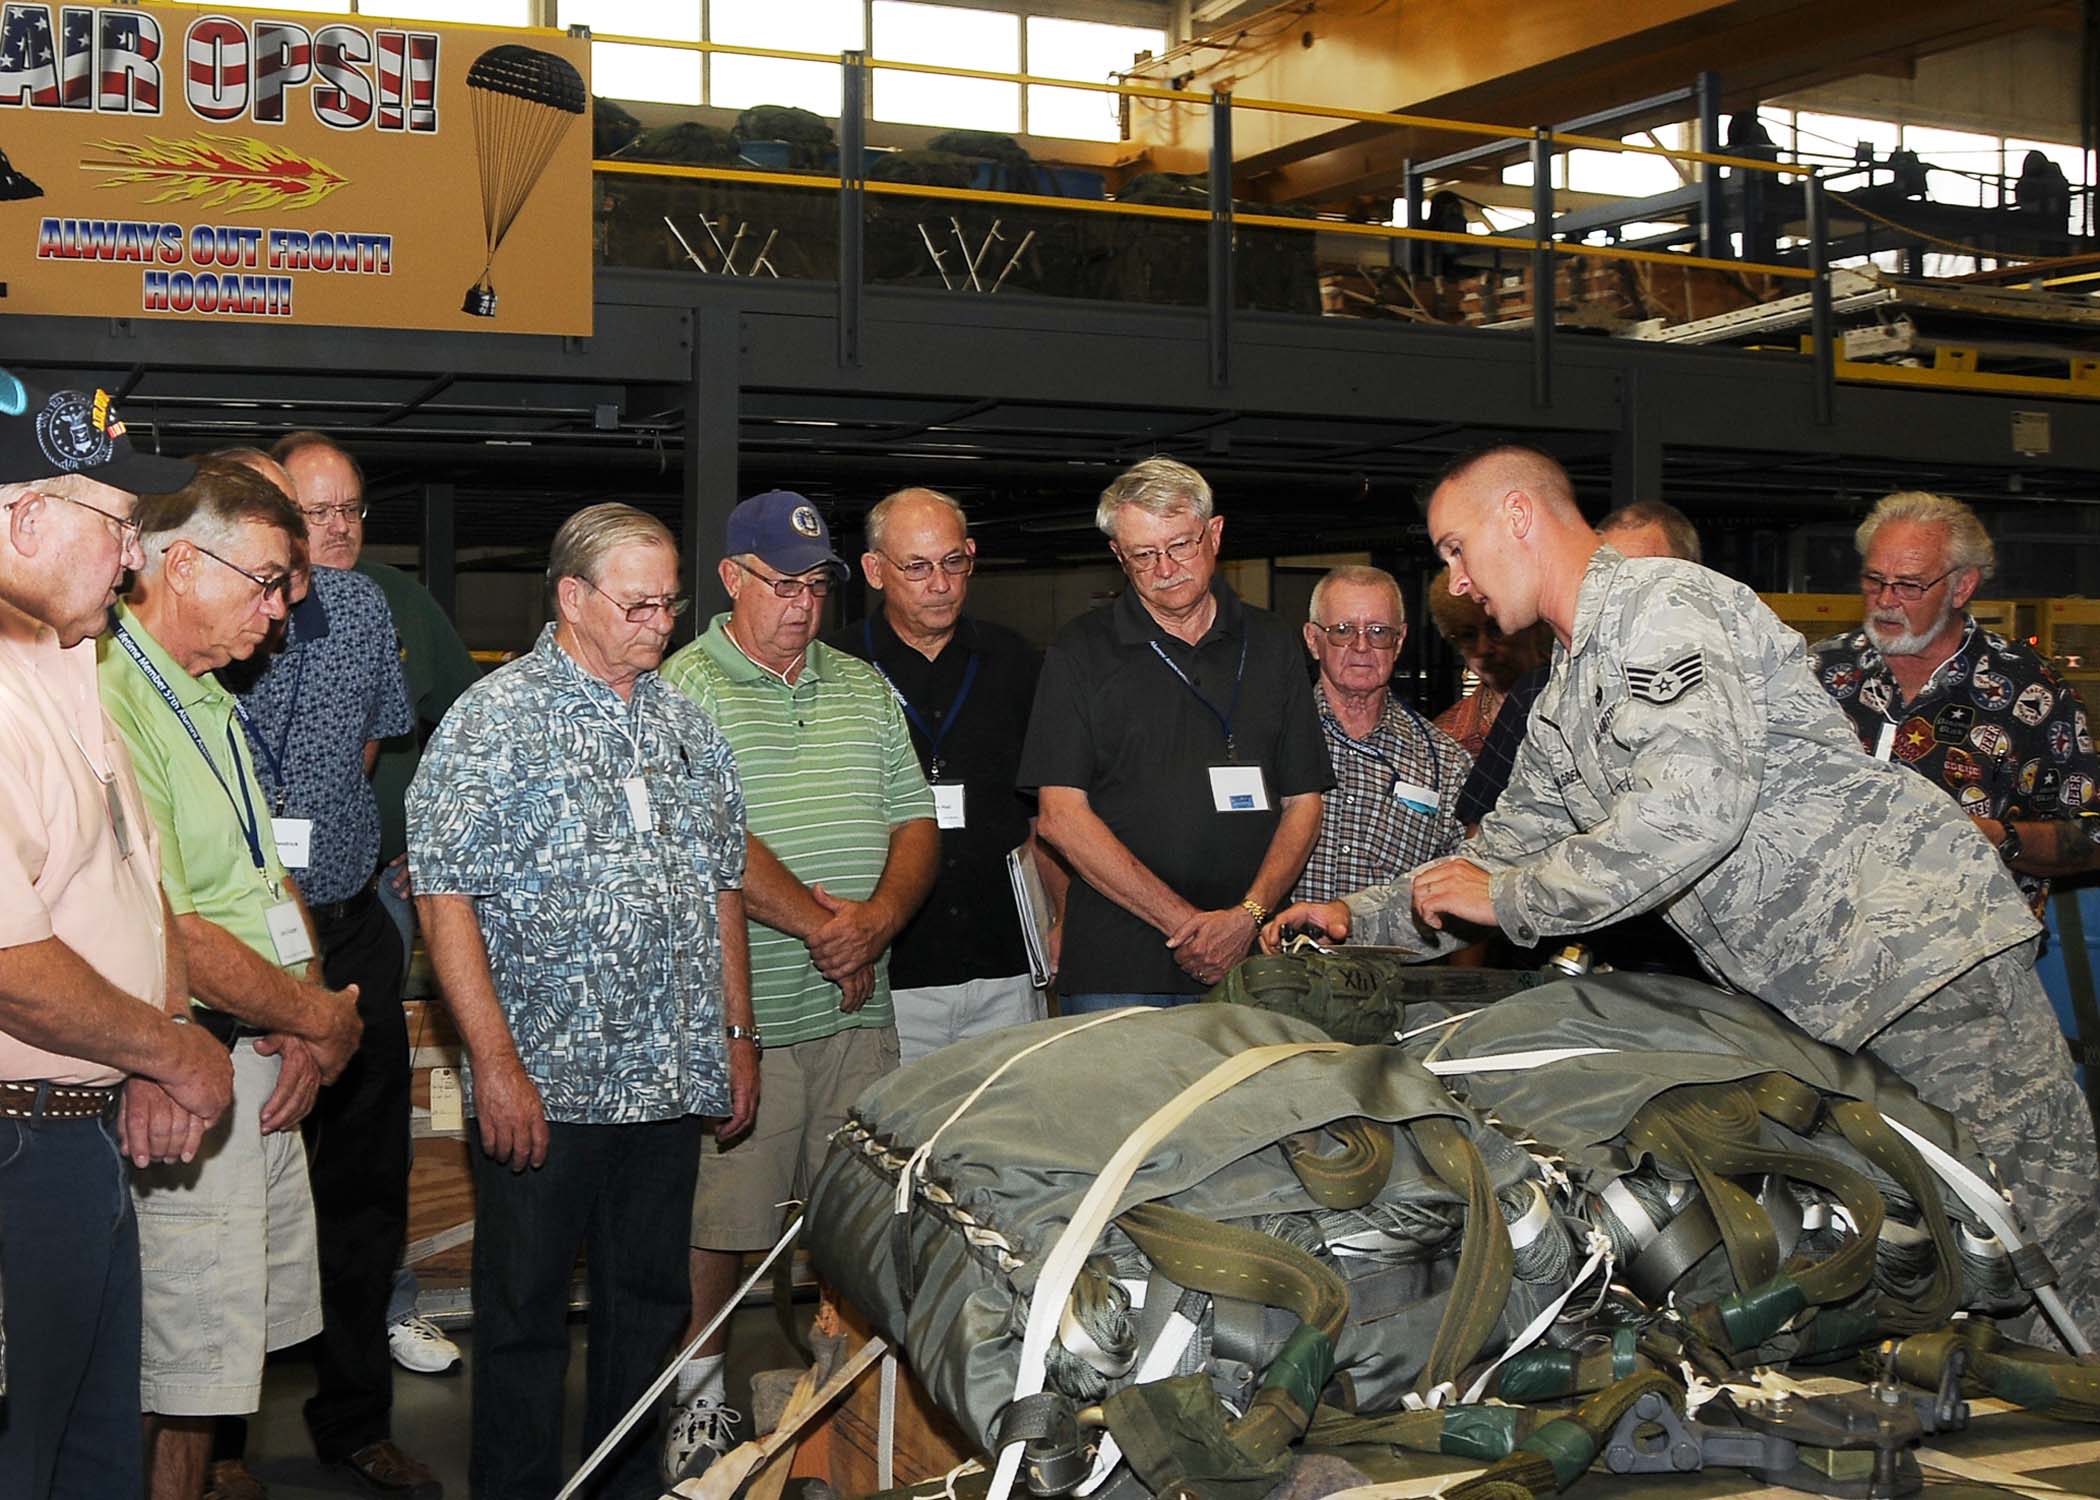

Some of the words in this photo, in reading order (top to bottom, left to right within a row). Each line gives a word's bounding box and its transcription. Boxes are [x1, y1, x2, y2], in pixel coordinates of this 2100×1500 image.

[0, 3, 163, 117] AIR
[186, 15, 438, 132] OPS!!
[38, 217, 184, 265] ALWAYS
[191, 224, 263, 268] OUT
[268, 228, 393, 274] FRONT!
[142, 269, 293, 316] HOOAH!!
[137, 655, 166, 692] Member
[162, 688, 180, 711] 57th
[1980, 725, 2001, 756] BEER
[2068, 775, 2081, 807] BEER
